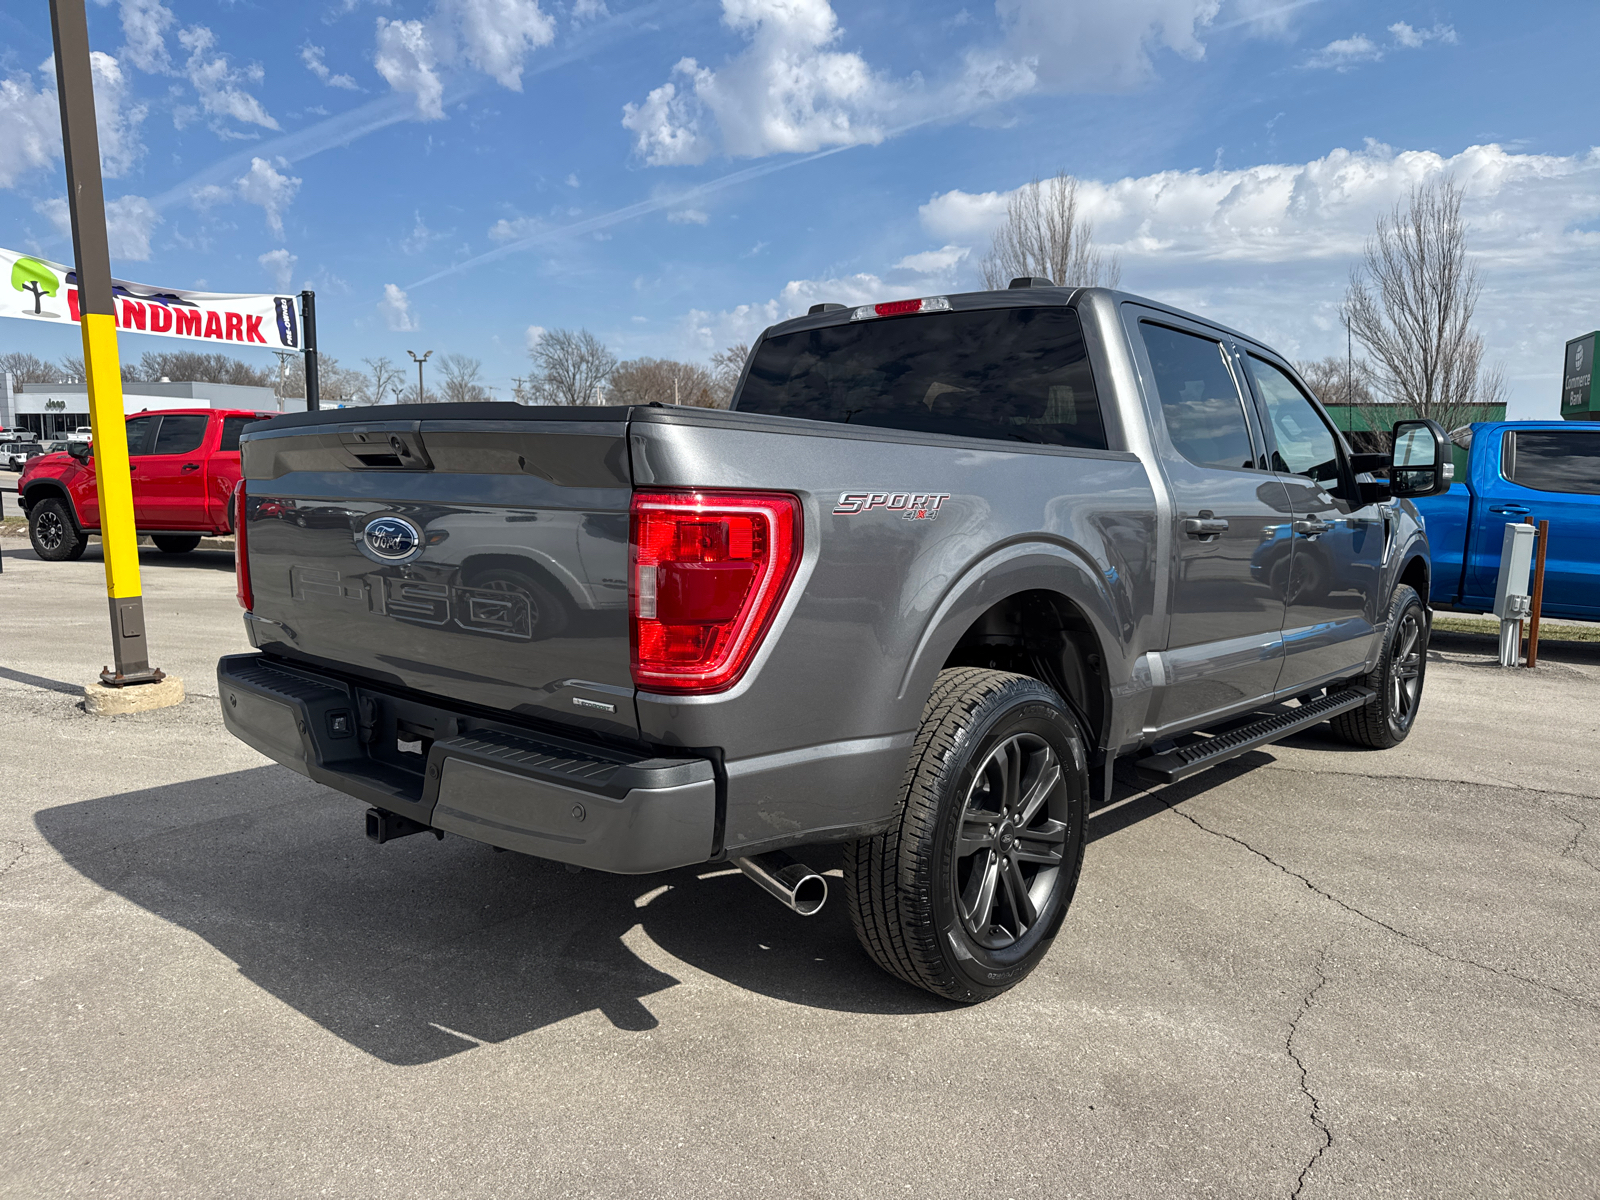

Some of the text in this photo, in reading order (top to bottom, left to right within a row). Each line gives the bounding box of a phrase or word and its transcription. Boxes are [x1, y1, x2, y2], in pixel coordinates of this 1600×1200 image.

[67, 289, 267, 344] LNDMARK
[281, 299, 293, 346] PRE-OWNED
[1565, 373, 1591, 390] Commerce
[1569, 389, 1583, 406] Bank
[832, 491, 951, 515] SPORT
[372, 525, 403, 550] Ford
[290, 565, 532, 639] F-150
